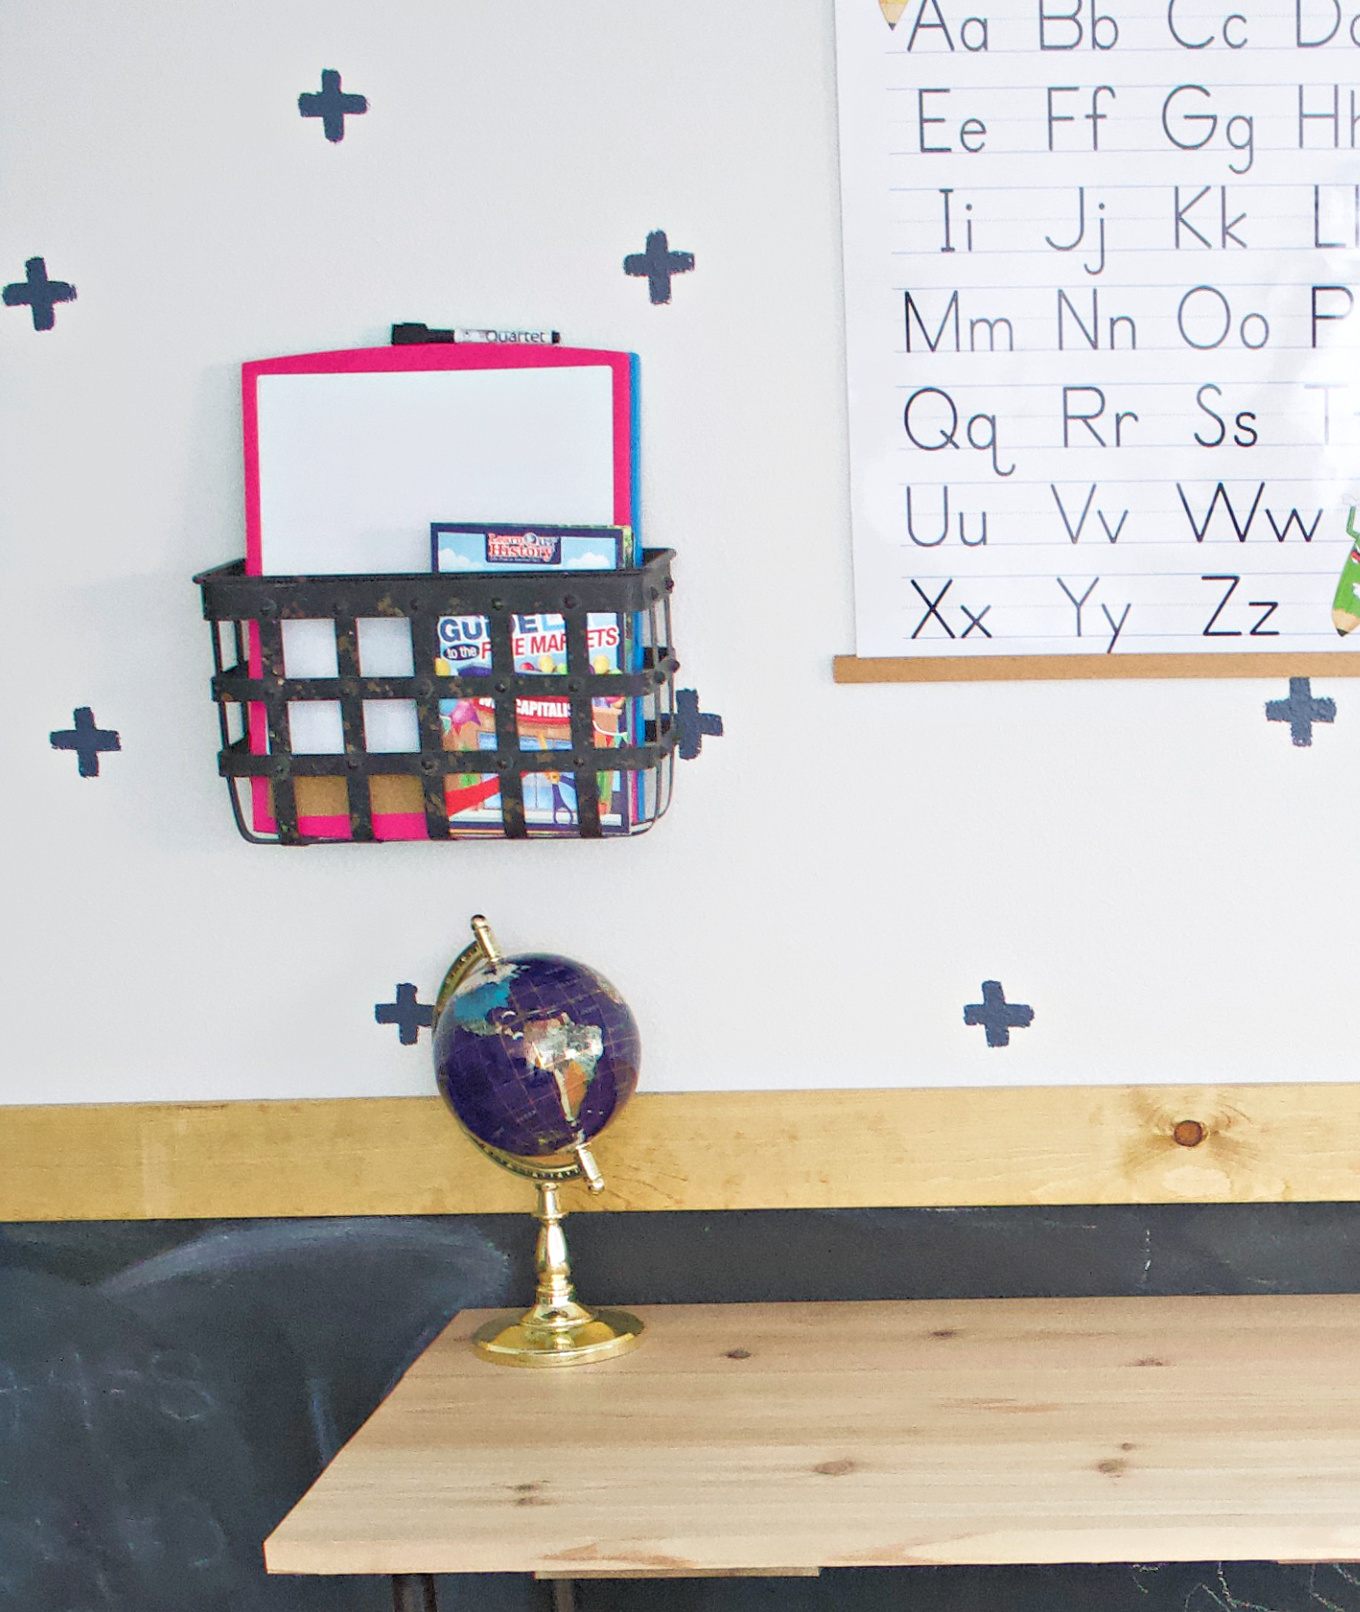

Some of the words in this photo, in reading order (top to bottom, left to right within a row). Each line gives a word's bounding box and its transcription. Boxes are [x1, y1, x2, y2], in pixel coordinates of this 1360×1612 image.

[907, 0, 989, 53] Aa
[1039, 0, 1120, 51] Bb
[1167, 0, 1249, 50] Cc
[917, 88, 988, 154] Ee
[1046, 85, 1117, 152] Ff
[1162, 84, 1255, 175] Gg
[937, 188, 973, 253] Ii
[1045, 186, 1106, 276] Jj
[1174, 185, 1247, 250] Kk
[1313, 184, 1360, 249] Ll
[486, 329, 546, 344] Quartet
[903, 289, 1014, 353] Mm
[1057, 287, 1137, 351] Nn
[1177, 284, 1270, 350] Oo
[904, 386, 1016, 477] Qq
[1062, 385, 1139, 448] Rr
[1194, 383, 1260, 448] Ss
[906, 485, 988, 548] Uu
[1050, 482, 1129, 545] Vv
[1176, 481, 1323, 544] Ww
[490, 542, 553, 563] History
[910, 579, 993, 640] Xx
[1056, 576, 1132, 655] Yy
[1200, 575, 1281, 637] Zz
[459, 645, 478, 658] the
